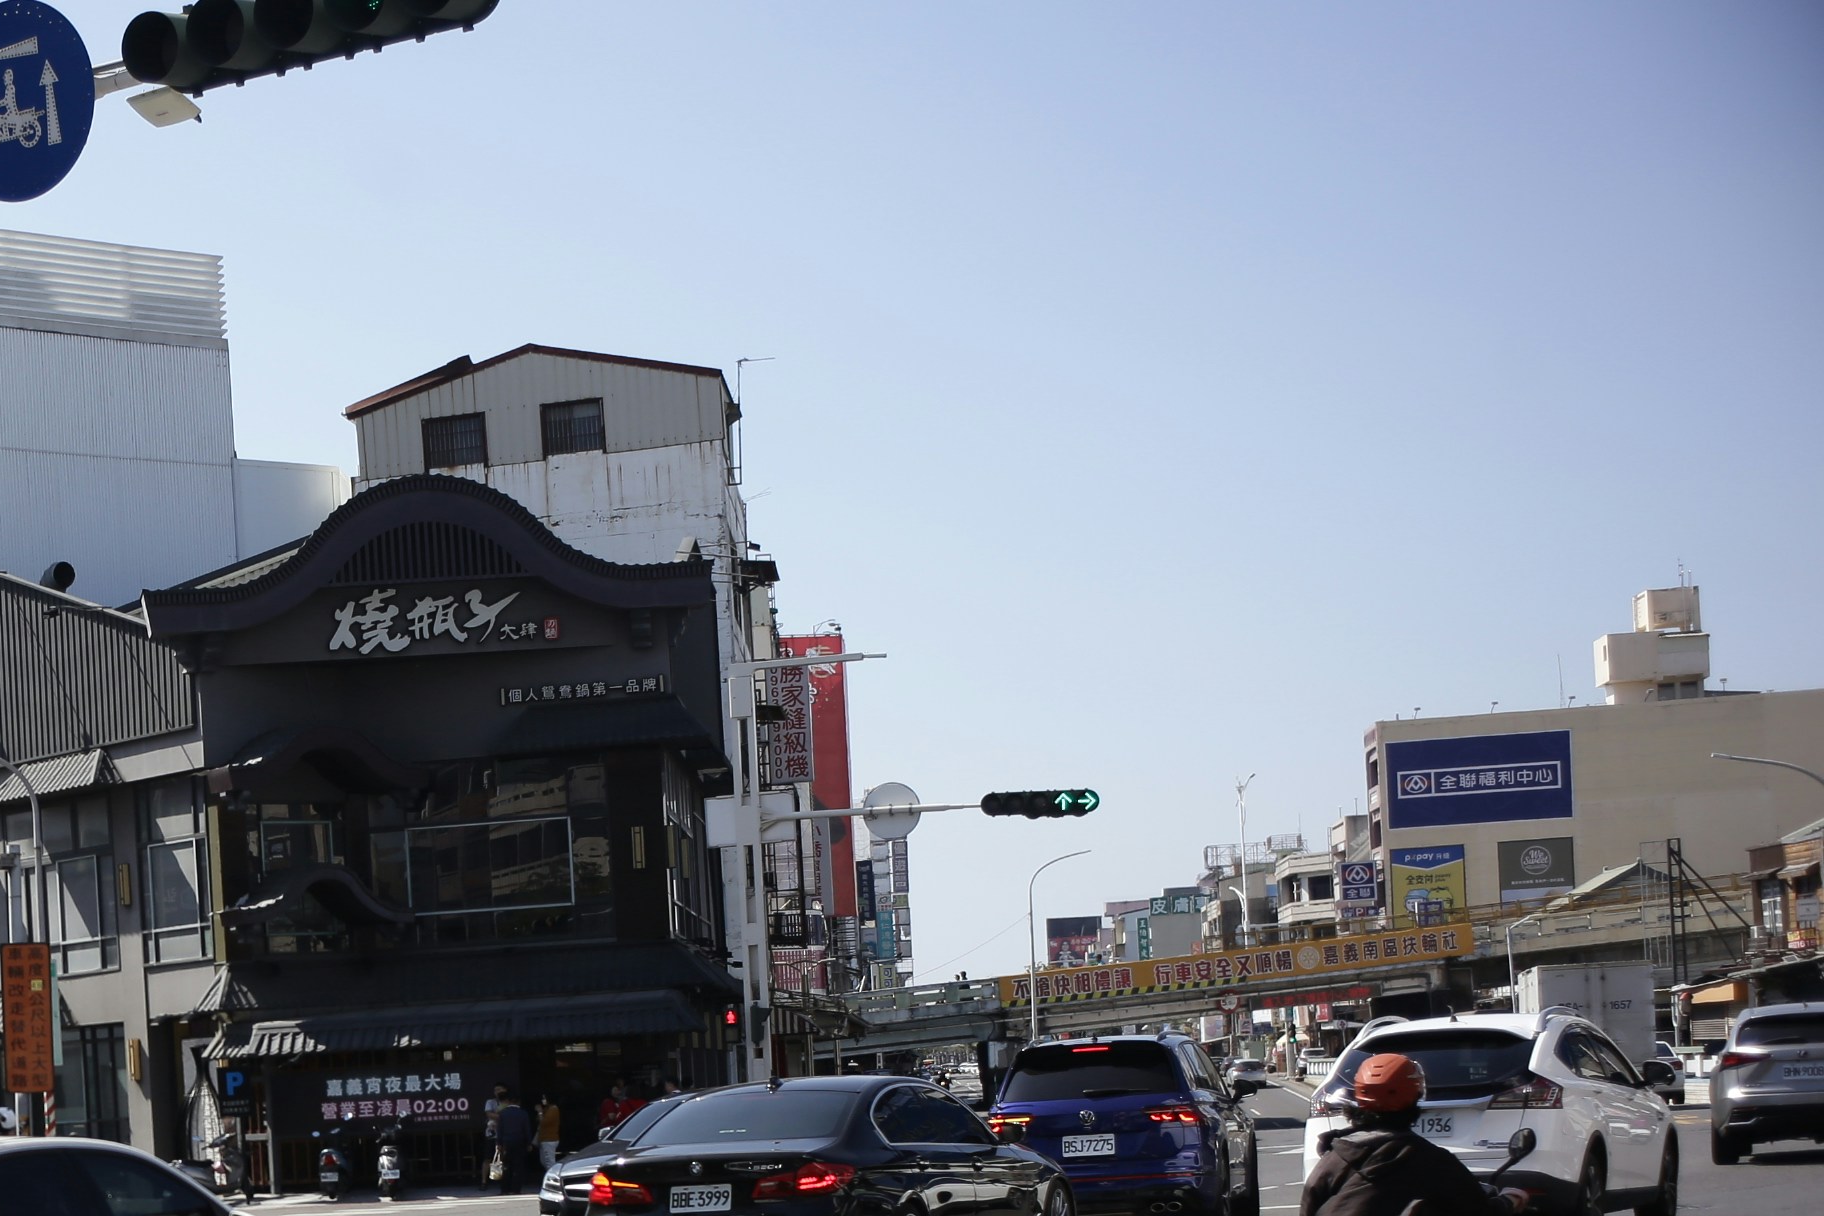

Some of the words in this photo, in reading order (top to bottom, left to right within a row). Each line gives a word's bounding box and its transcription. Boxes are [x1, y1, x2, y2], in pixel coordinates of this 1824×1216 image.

[508, 677, 658, 704] 個人鴛鴦鍋第一品牌
[780, 665, 809, 778] 勝家縫紉機
[1439, 767, 1553, 790] 全聯福利中心
[1405, 874, 1433, 885] 全支付
[1346, 887, 1371, 899] 全聯
[1355, 907, 1364, 916] P
[1153, 950, 1293, 987] 行車安全又順暢
[1323, 931, 1458, 966] 嘉義南區扶輪社
[1558, 1002, 1584, 1011] SA-
[1609, 999, 1632, 1010] 1657
[225, 1071, 244, 1096] P
[326, 1072, 462, 1097] 嘉義宵夜最大場
[1063, 1138, 1114, 1154] BSJ-7275
[671, 1190, 730, 1209] BBE-3999
